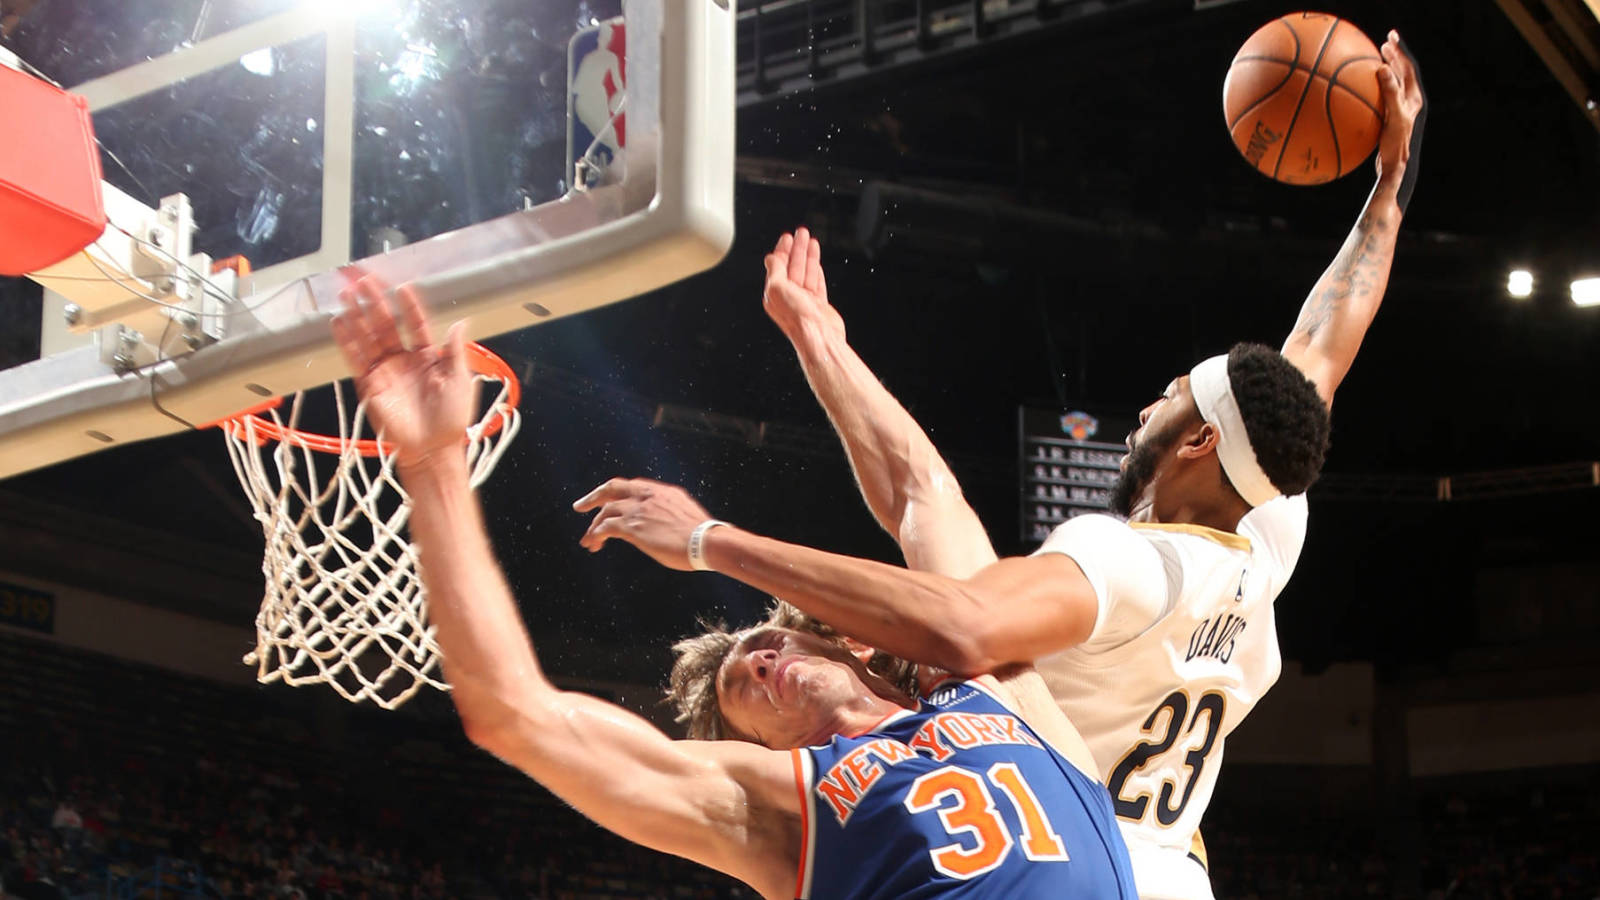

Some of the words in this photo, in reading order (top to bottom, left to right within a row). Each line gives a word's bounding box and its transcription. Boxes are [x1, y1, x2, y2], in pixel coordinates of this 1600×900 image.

[1185, 613, 1246, 664] DAVIS
[815, 739, 919, 829] NEW
[908, 712, 1045, 762] YORK
[1107, 687, 1227, 828] 23
[904, 762, 1070, 880] 31
